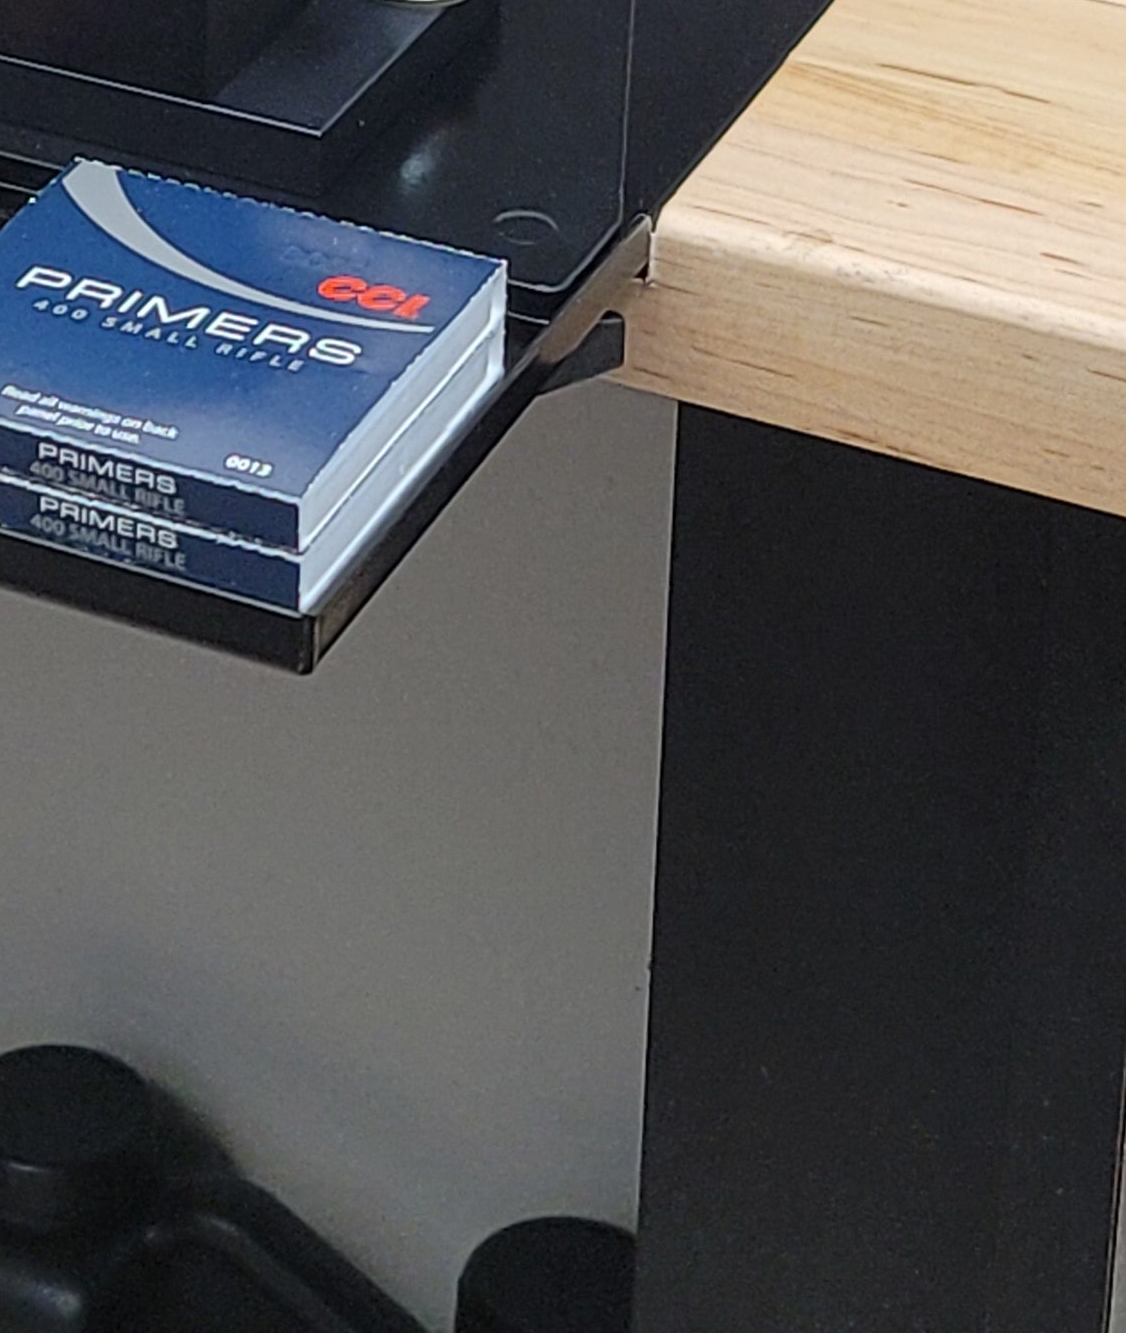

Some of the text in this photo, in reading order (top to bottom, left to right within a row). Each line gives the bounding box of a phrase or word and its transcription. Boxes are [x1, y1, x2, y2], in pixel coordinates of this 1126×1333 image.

[16, 265, 362, 366] PRIMERS
[318, 274, 431, 321] CCI
[33, 299, 305, 373] 400 SMALL RIFLE
[29, 460, 186, 515] 400 SMALL RIFLE
[38, 442, 178, 495] PRIMERS
[30, 514, 187, 570] 400 SMALL RIFLE
[39, 495, 179, 550] PRIMERS
